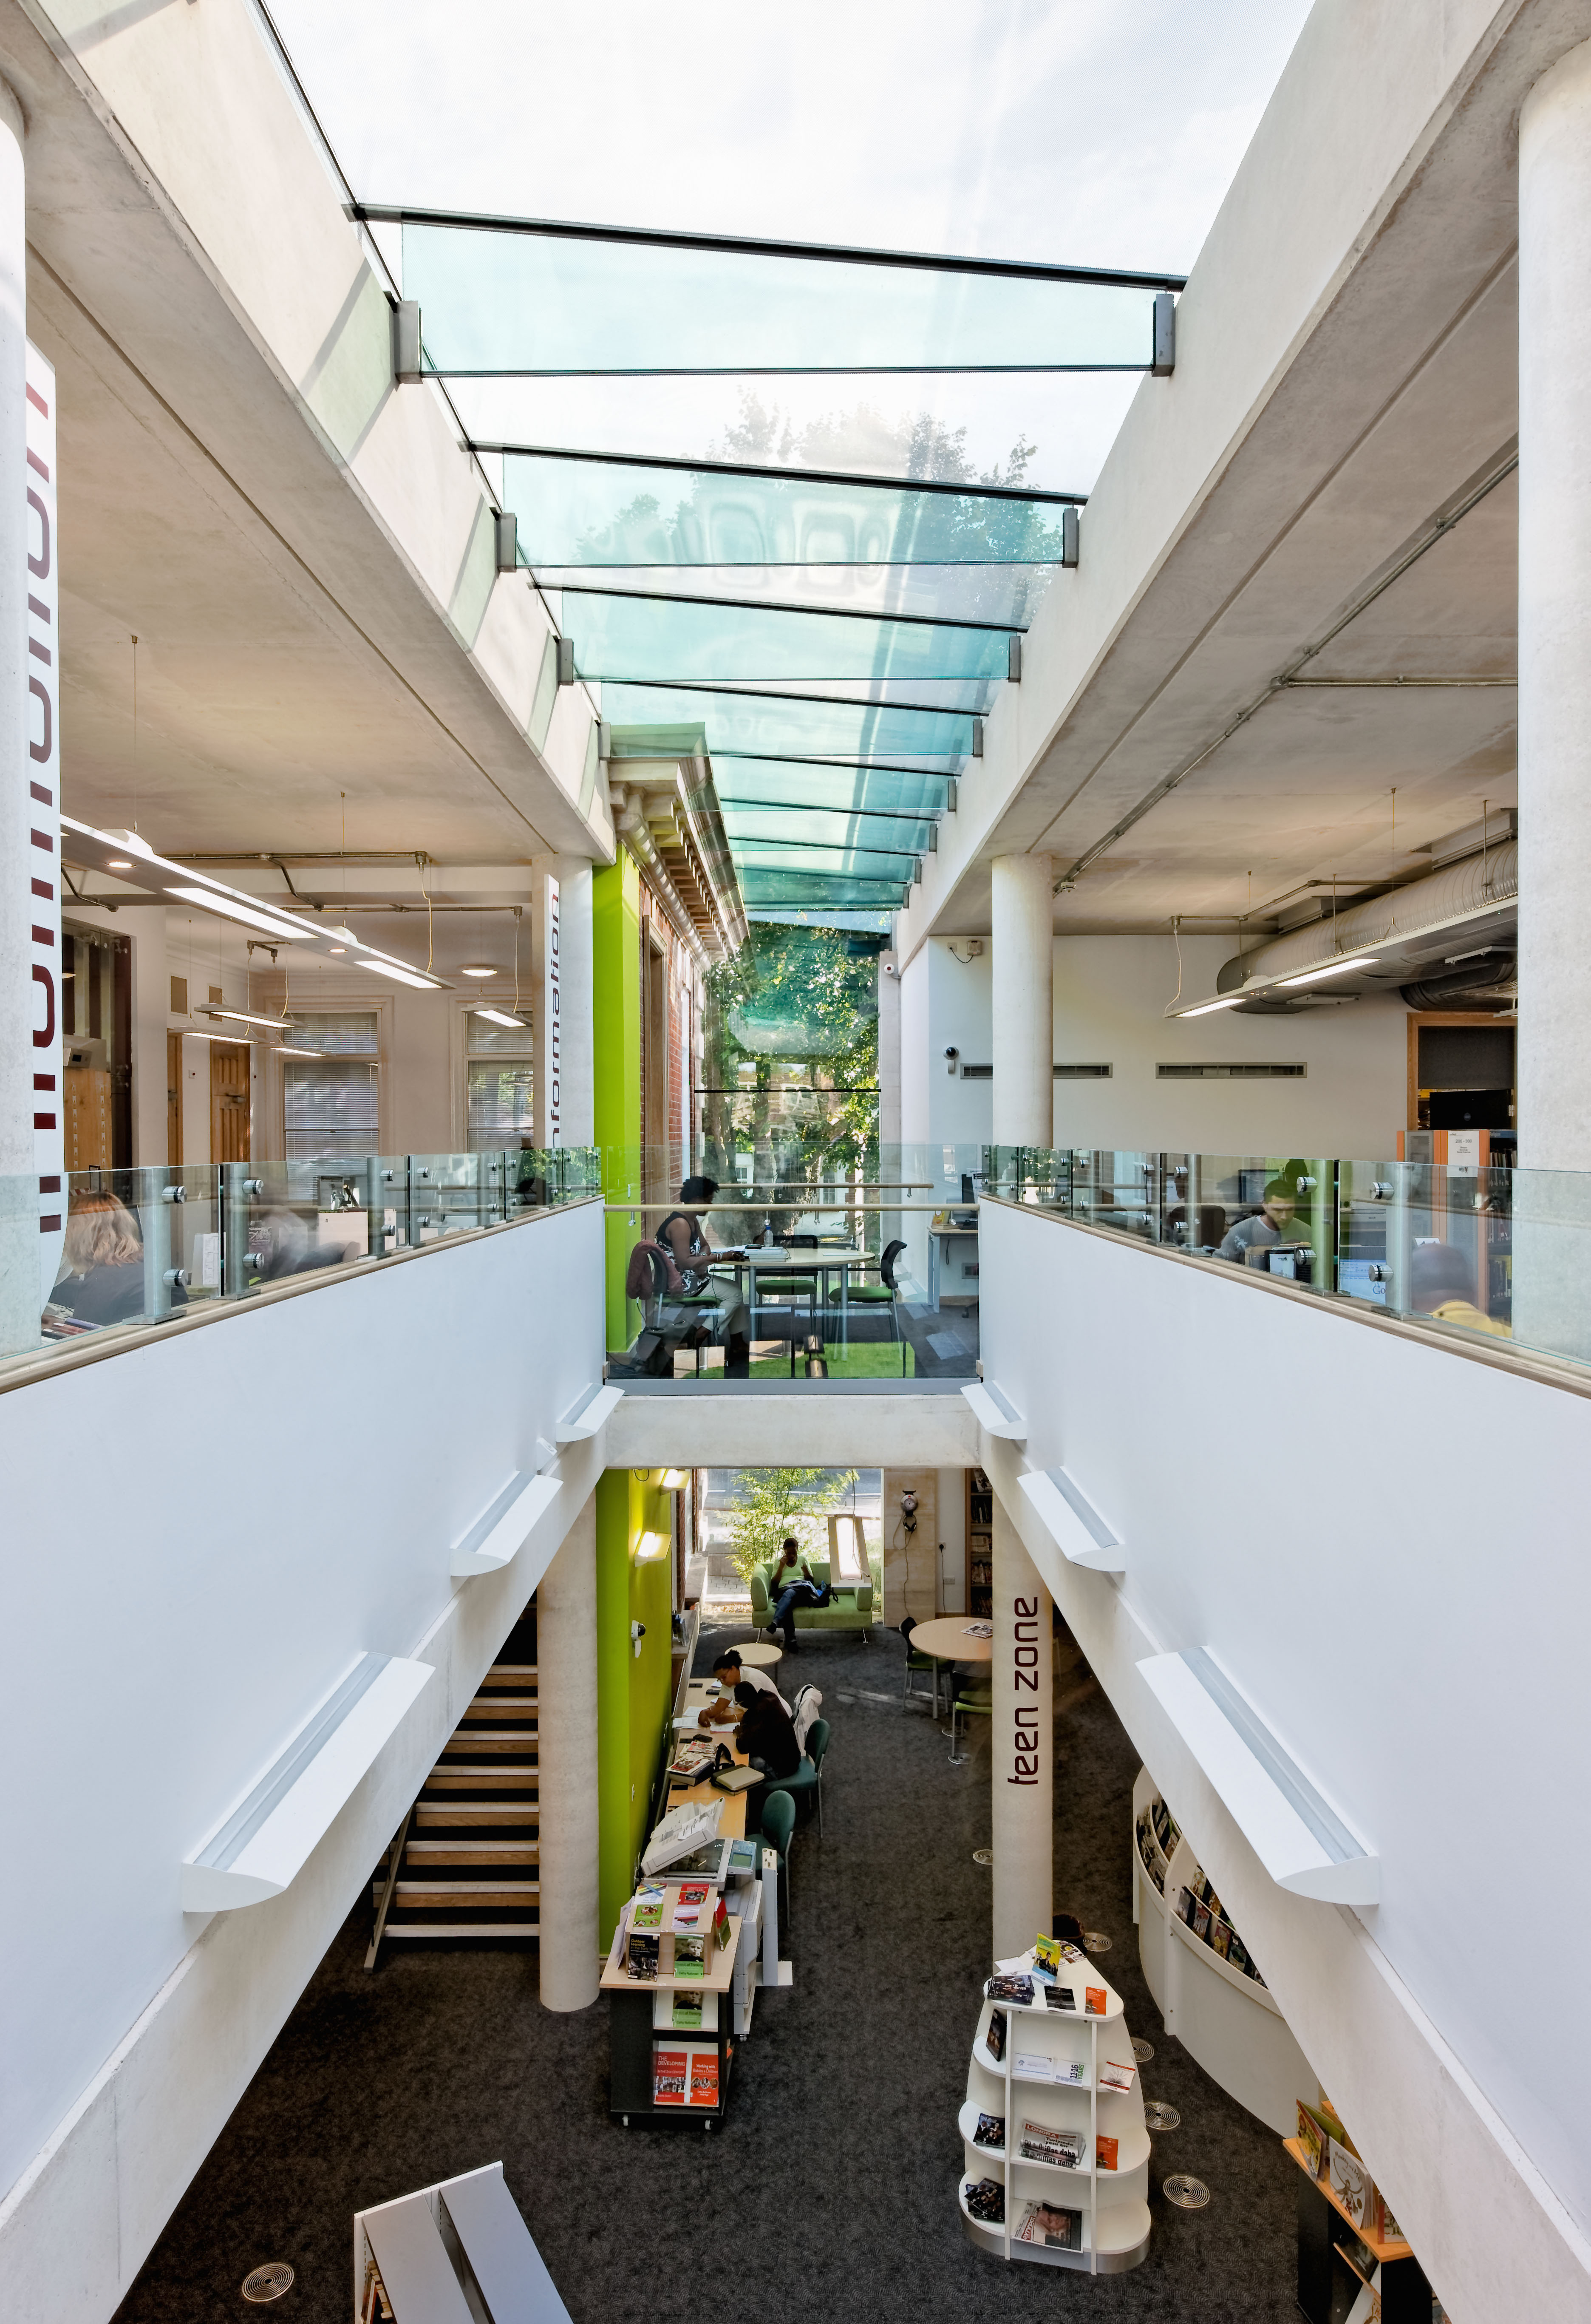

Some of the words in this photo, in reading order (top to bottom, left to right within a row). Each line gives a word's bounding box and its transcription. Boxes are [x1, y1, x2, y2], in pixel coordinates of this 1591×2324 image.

[551, 893, 560, 1148] nformation
[1014, 1597, 1038, 1691] zone
[1008, 1707, 1038, 1785] teen
[1027, 2125, 1056, 2137] LONDRA
[1046, 2137, 1073, 2146] Turizmde
